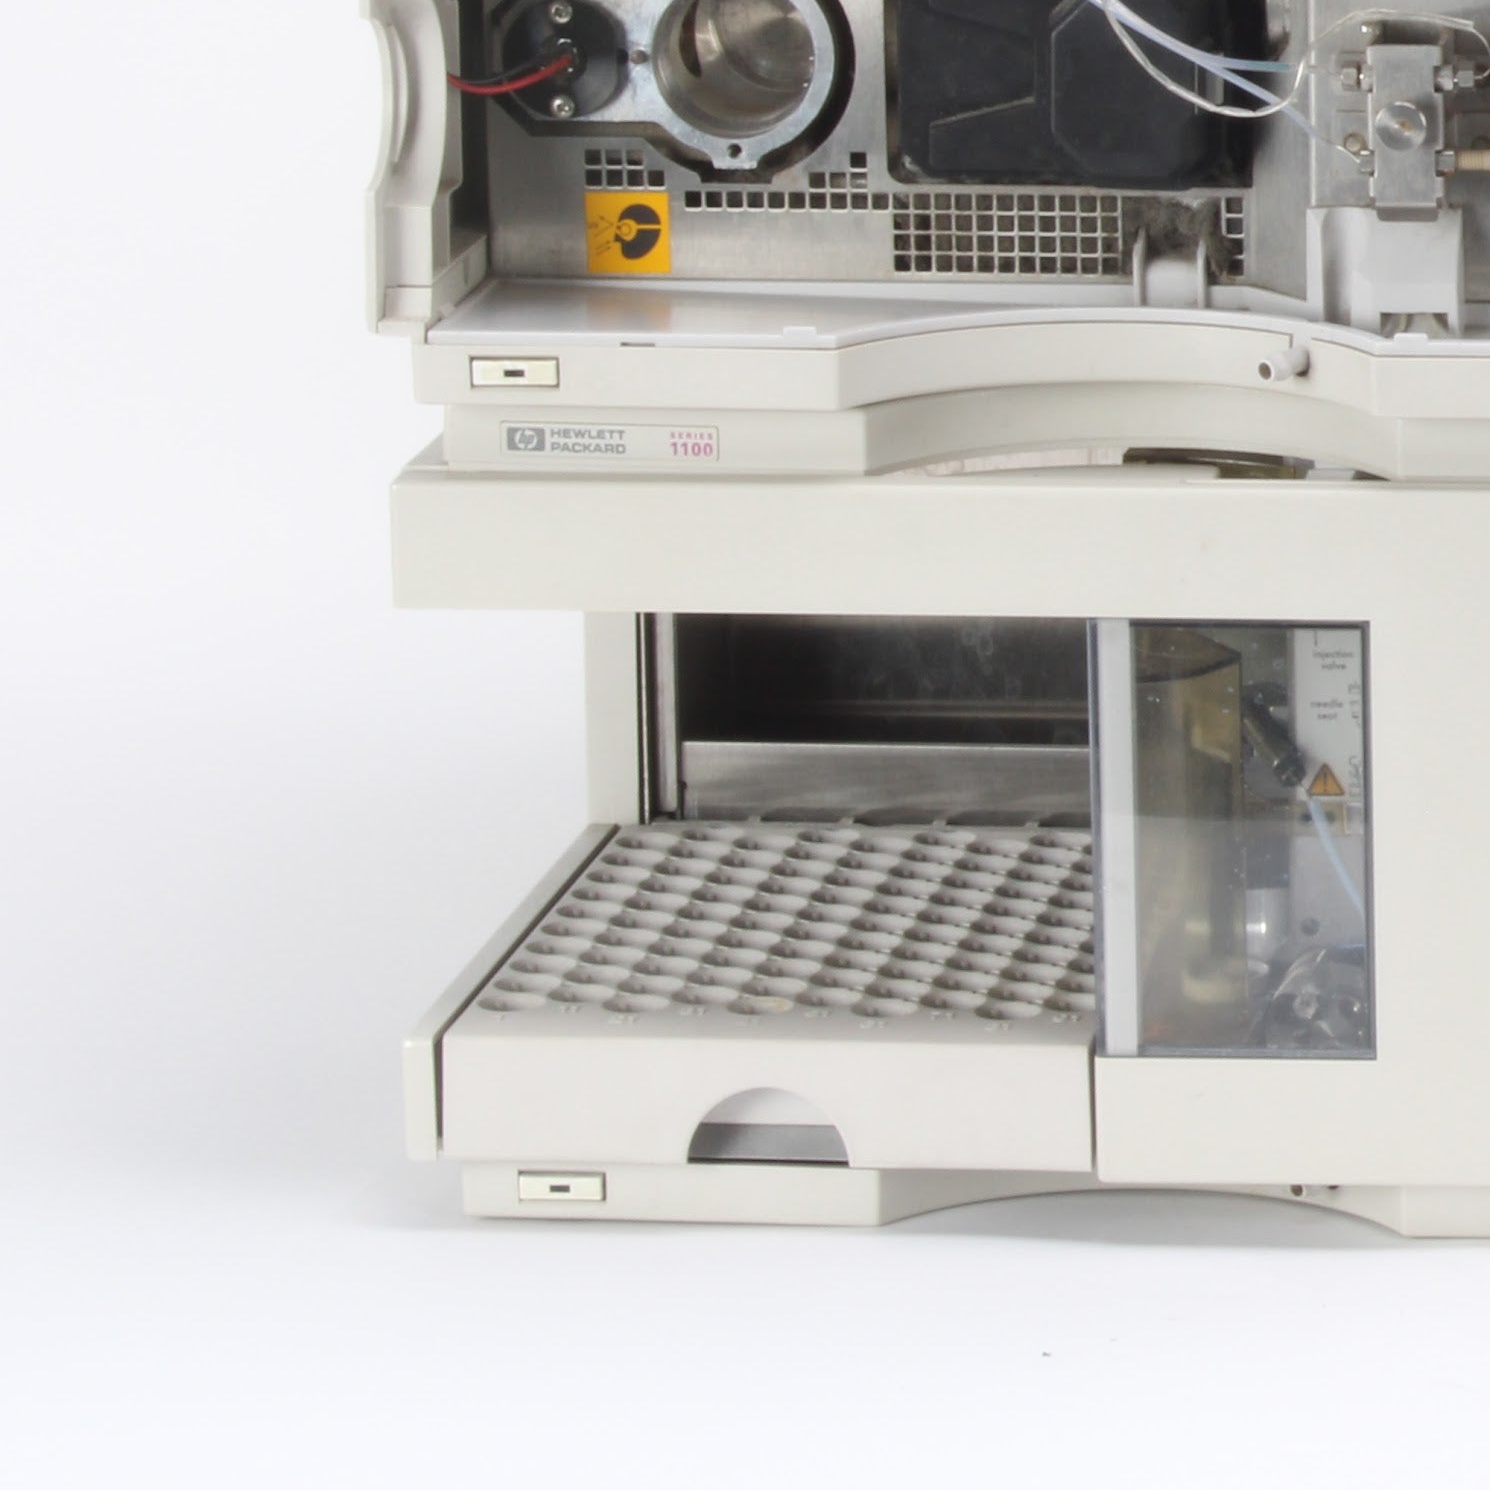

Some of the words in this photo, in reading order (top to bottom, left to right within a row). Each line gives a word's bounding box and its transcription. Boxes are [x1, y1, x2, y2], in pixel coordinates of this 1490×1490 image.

[550, 428, 626, 441] HEWLETT
[670, 431, 714, 441] SERIES
[550, 442, 626, 455] PACKARD
[670, 442, 714, 457] 1100
